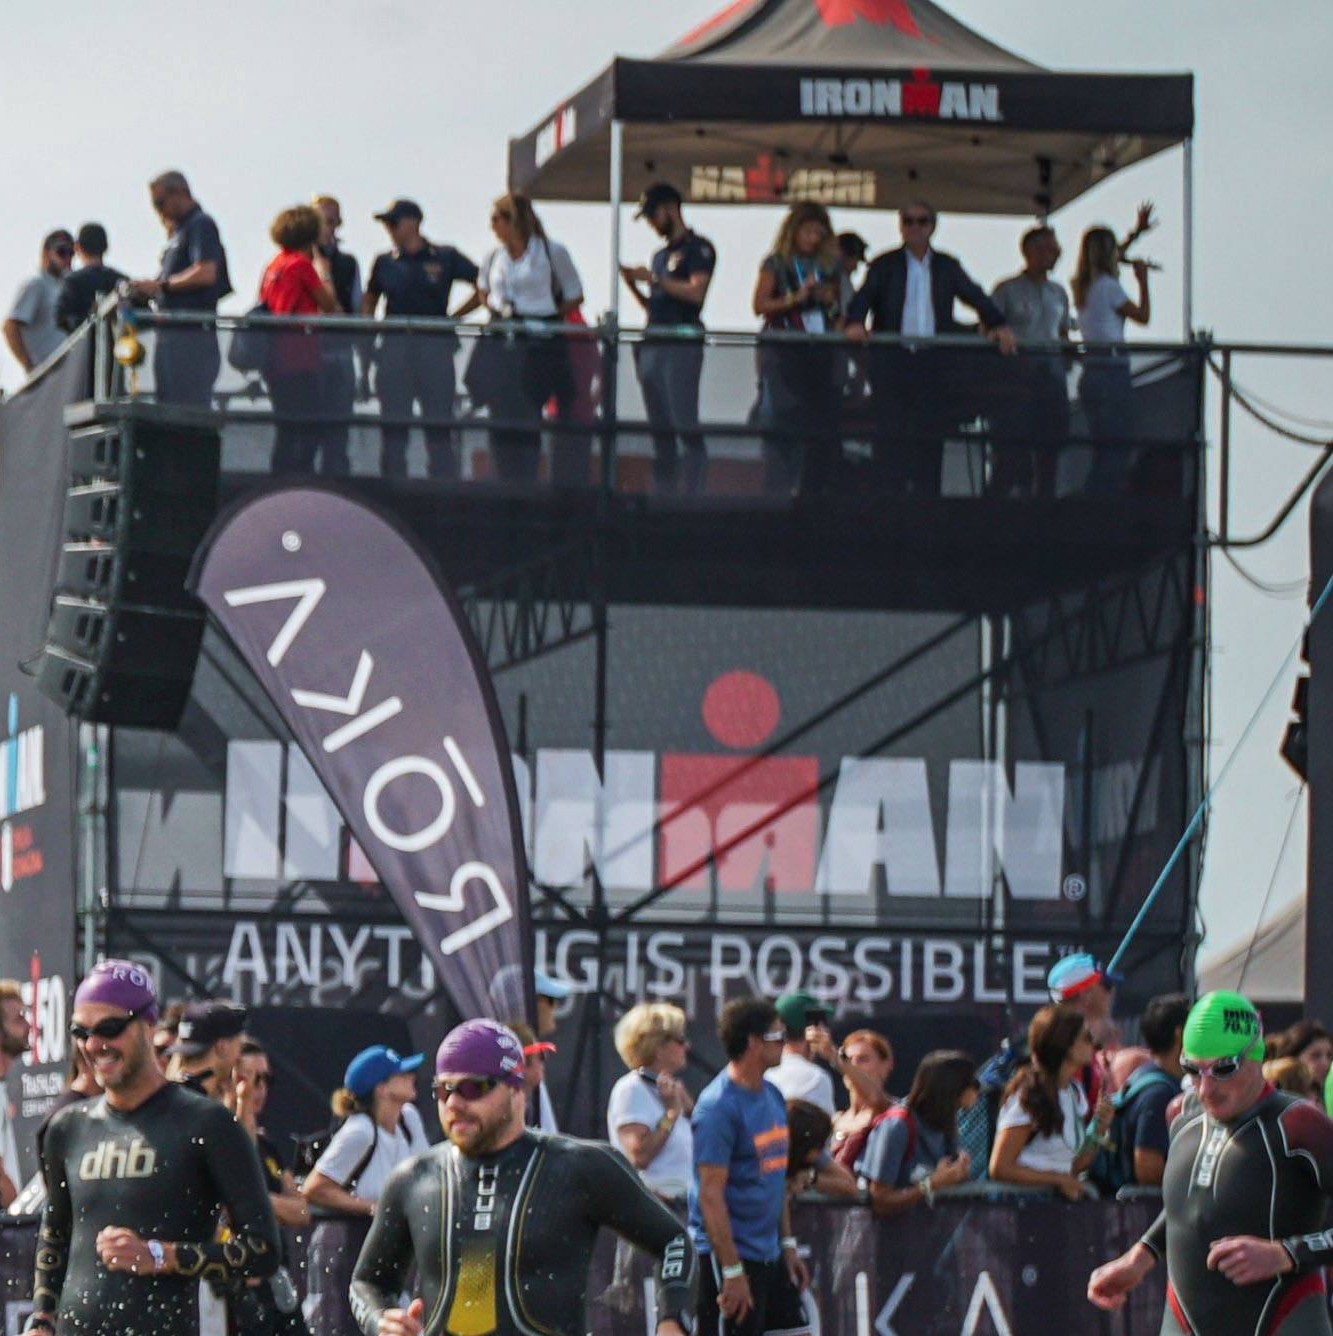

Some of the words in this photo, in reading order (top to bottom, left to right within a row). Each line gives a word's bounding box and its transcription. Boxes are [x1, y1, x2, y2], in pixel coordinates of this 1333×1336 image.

[799, 67, 1002, 121] IRONMAN
[223, 669, 1065, 898] INMAN
[226, 924, 600, 992] ANYTG
[626, 932, 686, 997] IS
[711, 935, 1050, 1006] POSSIBLE
[79, 1139, 156, 1181] dhb
